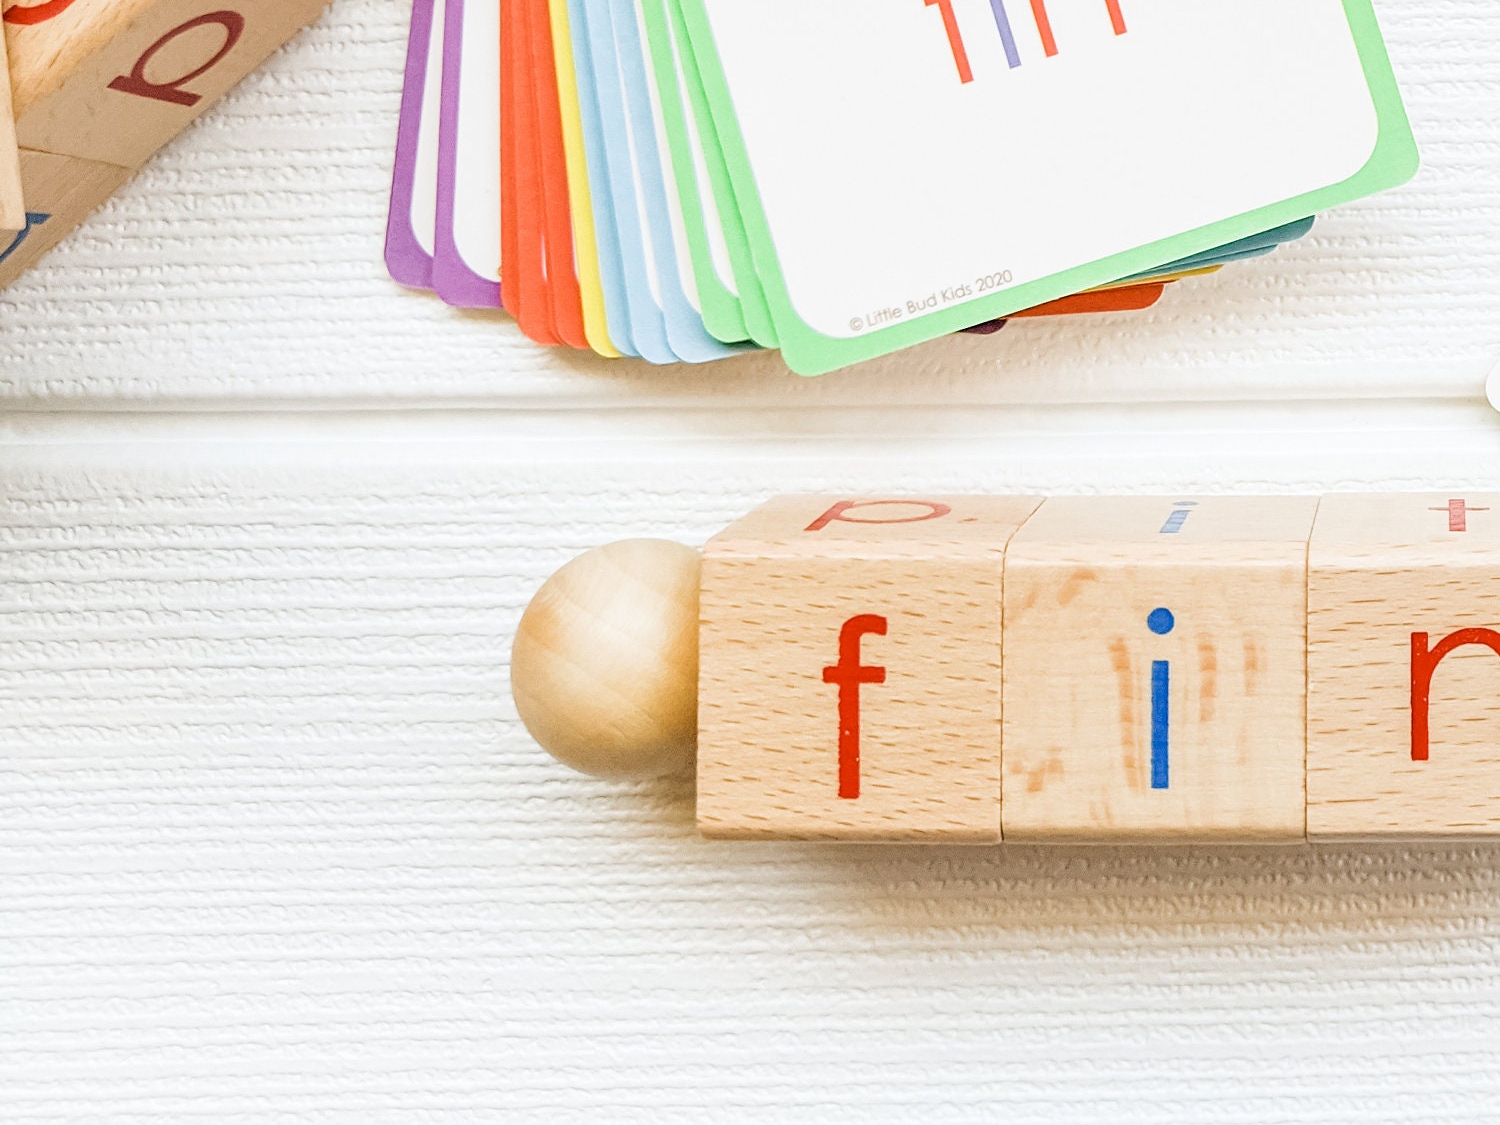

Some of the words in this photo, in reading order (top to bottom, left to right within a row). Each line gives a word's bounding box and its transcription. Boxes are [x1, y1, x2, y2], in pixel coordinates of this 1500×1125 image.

[866, 307, 902, 328] Little
[906, 294, 938, 314] Bud
[941, 284, 973, 301] Kids
[975, 269, 1013, 292] 2020
